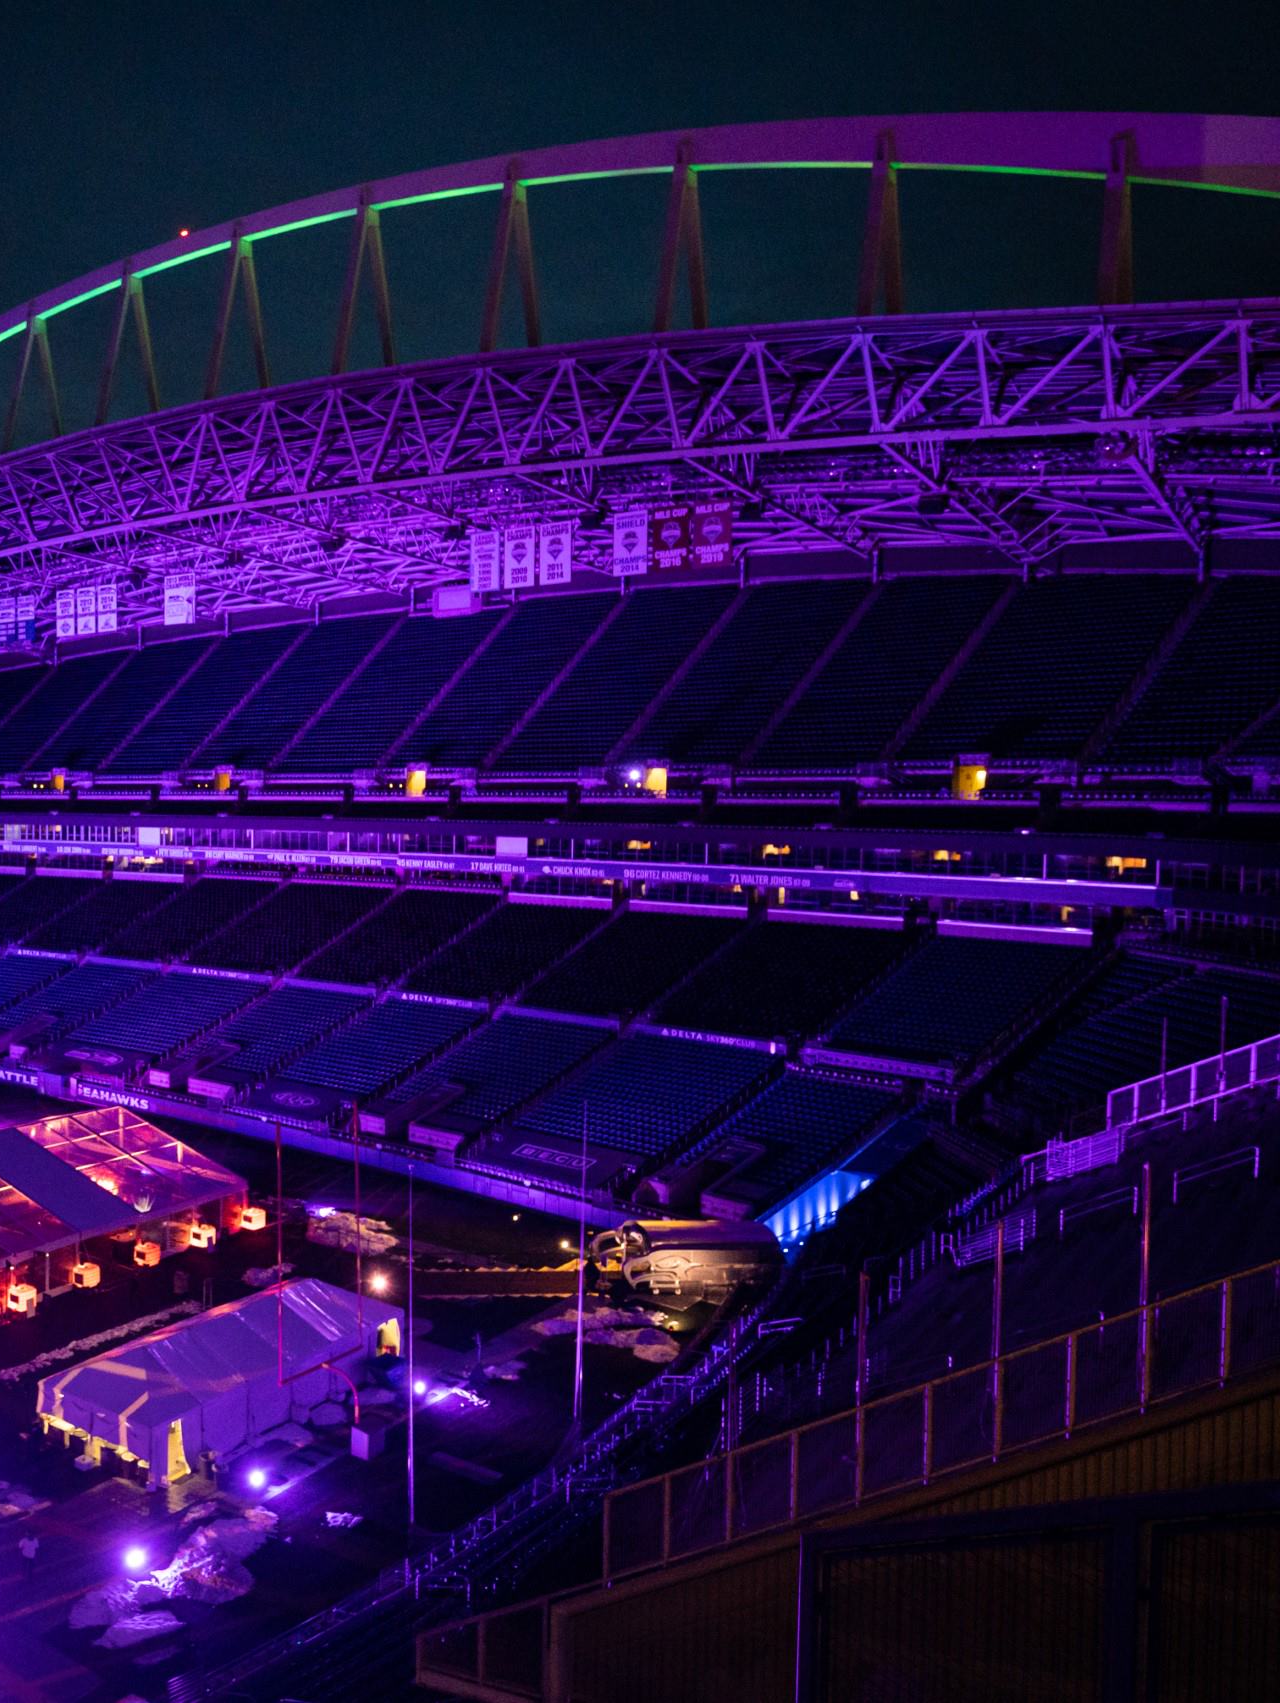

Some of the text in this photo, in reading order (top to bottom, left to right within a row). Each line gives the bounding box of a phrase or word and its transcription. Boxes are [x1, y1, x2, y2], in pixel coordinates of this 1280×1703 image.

[616, 519, 646, 530] SHIELD
[406, 860, 423, 869] KENNY
[424, 860, 443, 870] EASLEY
[471, 862, 479, 871] 17
[479, 862, 493, 872] DAVE
[494, 863, 512, 872] KRIEG
[553, 866, 573, 875] CHUCK
[574, 867, 591, 876] KNOX
[624, 869, 636, 879] 96
[636, 870, 660, 880] CORTEZ
[661, 871, 692, 881] KENNEDY
[730, 873, 740, 883] 71
[740, 874, 769, 885] WALTER
[770, 876, 793, 886] JONES
[408, 993, 433, 1003] DELTA
[671, 1028, 703, 1041] DELTA
